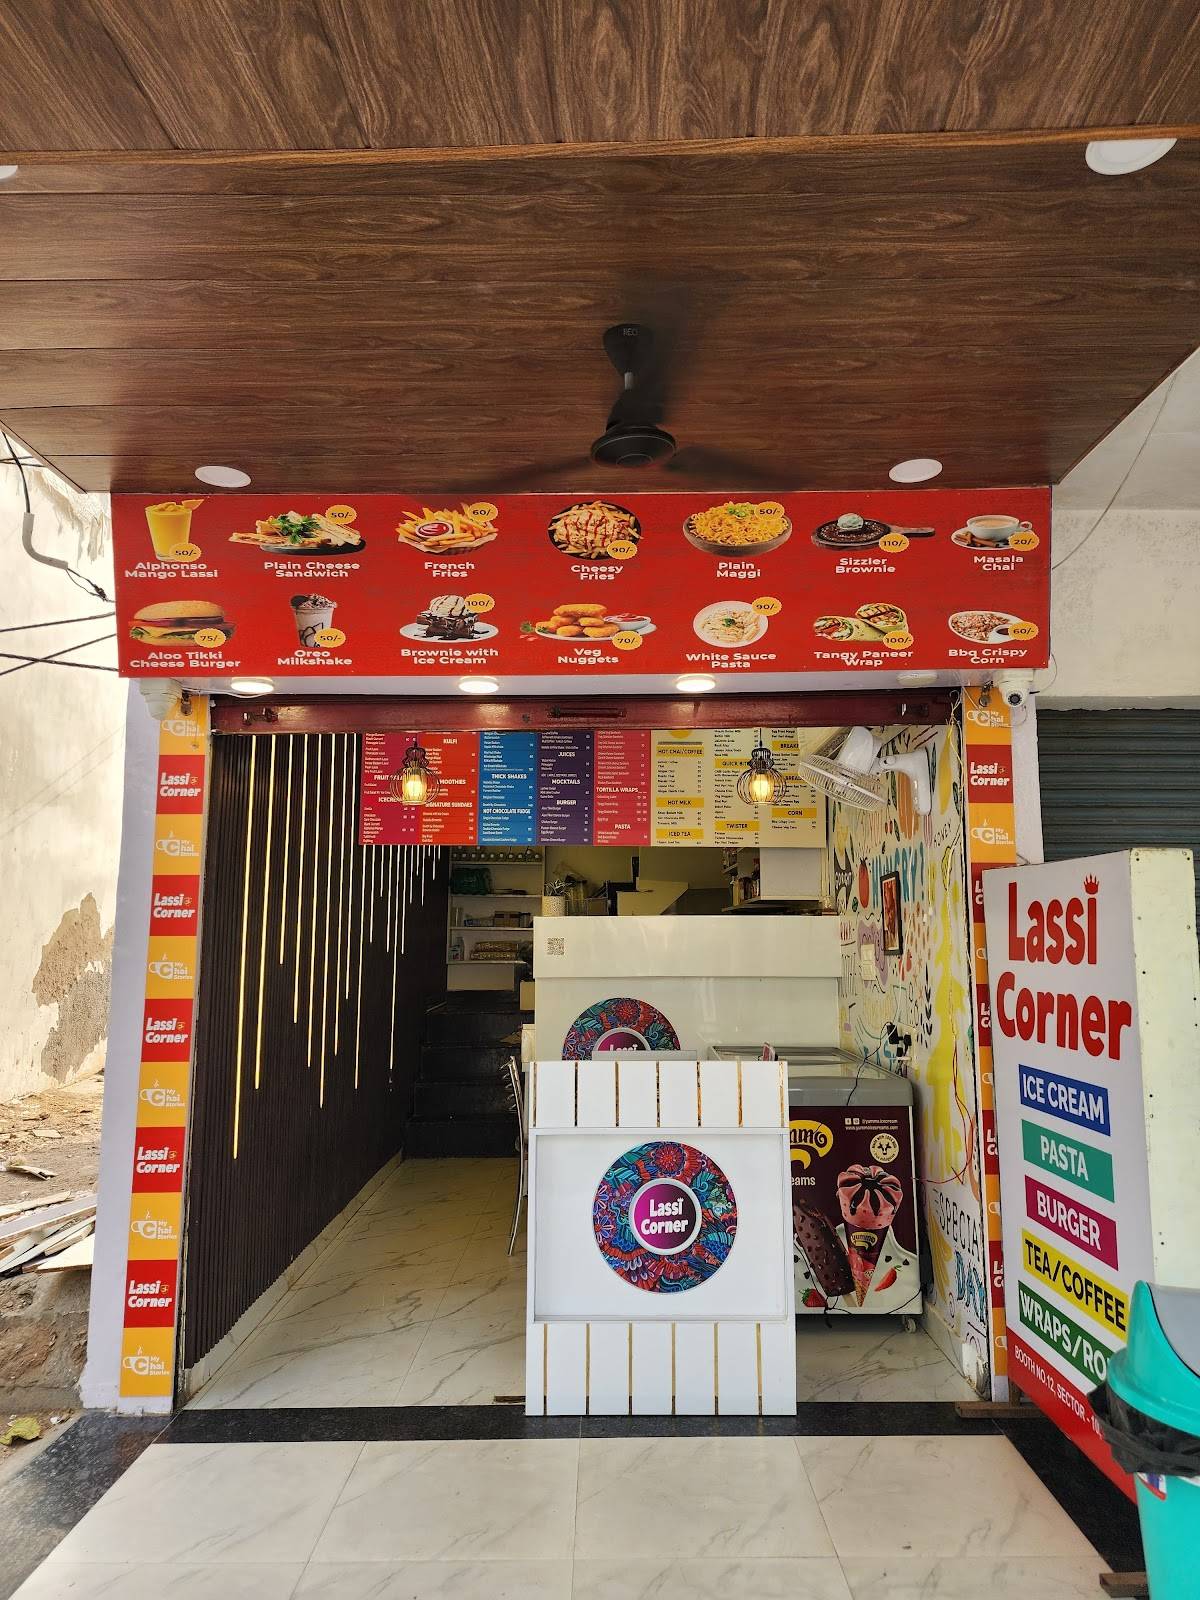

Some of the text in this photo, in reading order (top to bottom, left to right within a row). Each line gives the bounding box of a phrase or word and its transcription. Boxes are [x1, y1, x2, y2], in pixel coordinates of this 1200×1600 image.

[331, 511, 353, 520] 50/-
[472, 508, 494, 517] 60/-
[759, 507, 781, 517] 50/-
[882, 539, 907, 548] 110/-
[1013, 538, 1036, 547] 20/-
[175, 549, 197, 558] 50/-
[611, 546, 634, 555] 90/-
[838, 557, 888, 566] Sizzler
[974, 556, 1023, 564] Masala
[134, 561, 208, 571] Alphonso
[263, 561, 361, 570] Plain Cheese
[423, 561, 475, 570] French
[570, 564, 624, 574] Cheesy
[718, 561, 755, 570] Plain
[836, 565, 895, 573] Brownie
[124, 569, 218, 580] Mango Lassi
[275, 568, 349, 577] Sandwich
[431, 570, 469, 578] Fries
[579, 573, 615, 581] Fries
[717, 569, 760, 578] Maggi
[466, 599, 492, 608] 100/-
[755, 602, 778, 611] 90/-
[1013, 627, 1036, 635] 60/-
[200, 634, 222, 642] 75/-
[319, 634, 342, 642] 50/-
[617, 637, 638, 645] 70/-
[886, 636, 912, 645] 100/-
[184, 651, 224, 660] Tikki
[294, 650, 331, 658] Oreo
[400, 648, 498, 657] Brownie with
[574, 648, 602, 657] Veg
[685, 652, 777, 661] White Sauce
[814, 649, 913, 661] Tangy Paneer
[949, 648, 1027, 659] Bbq Crispy
[129, 659, 241, 669] Cheese Burger
[277, 658, 353, 667] Milkshake
[413, 656, 487, 665] Ice Cream
[558, 654, 618, 664] Nuggets
[844, 658, 882, 666] Wrap
[970, 761, 999, 776] Lassi
[161, 773, 190, 785] Lassi
[971, 775, 1009, 785] Corner
[160, 786, 200, 796] Corner
[154, 893, 184, 906] Lassi
[154, 905, 195, 918] Corner
[1008, 873, 1100, 965] Lassi
[997, 971, 1132, 1060] Corner
[146, 1018, 177, 1030] Lassi
[146, 1032, 188, 1043] Corner
[1023, 1073, 1104, 1125] ICE CREAM
[137, 1147, 169, 1163] Lassi
[1040, 1135, 1089, 1182] PASTA
[137, 1162, 180, 1173] Corner
[791, 1175, 816, 1187] eams
[649, 1197, 684, 1217] Lassi
[1036, 1190, 1101, 1251] BURGER
[640, 1216, 689, 1236] Corner
[938, 1190, 981, 1262] SPECIA
[129, 1280, 160, 1297] Lassi
[1025, 1239, 1127, 1332] TEA/COFFEE
[128, 1296, 172, 1307] Corner
[1019, 1290, 1109, 1381] WRAPS/RO
[1014, 1345, 1036, 1376] BOOTH
[1056, 1384, 1086, 1422] SECTOR
